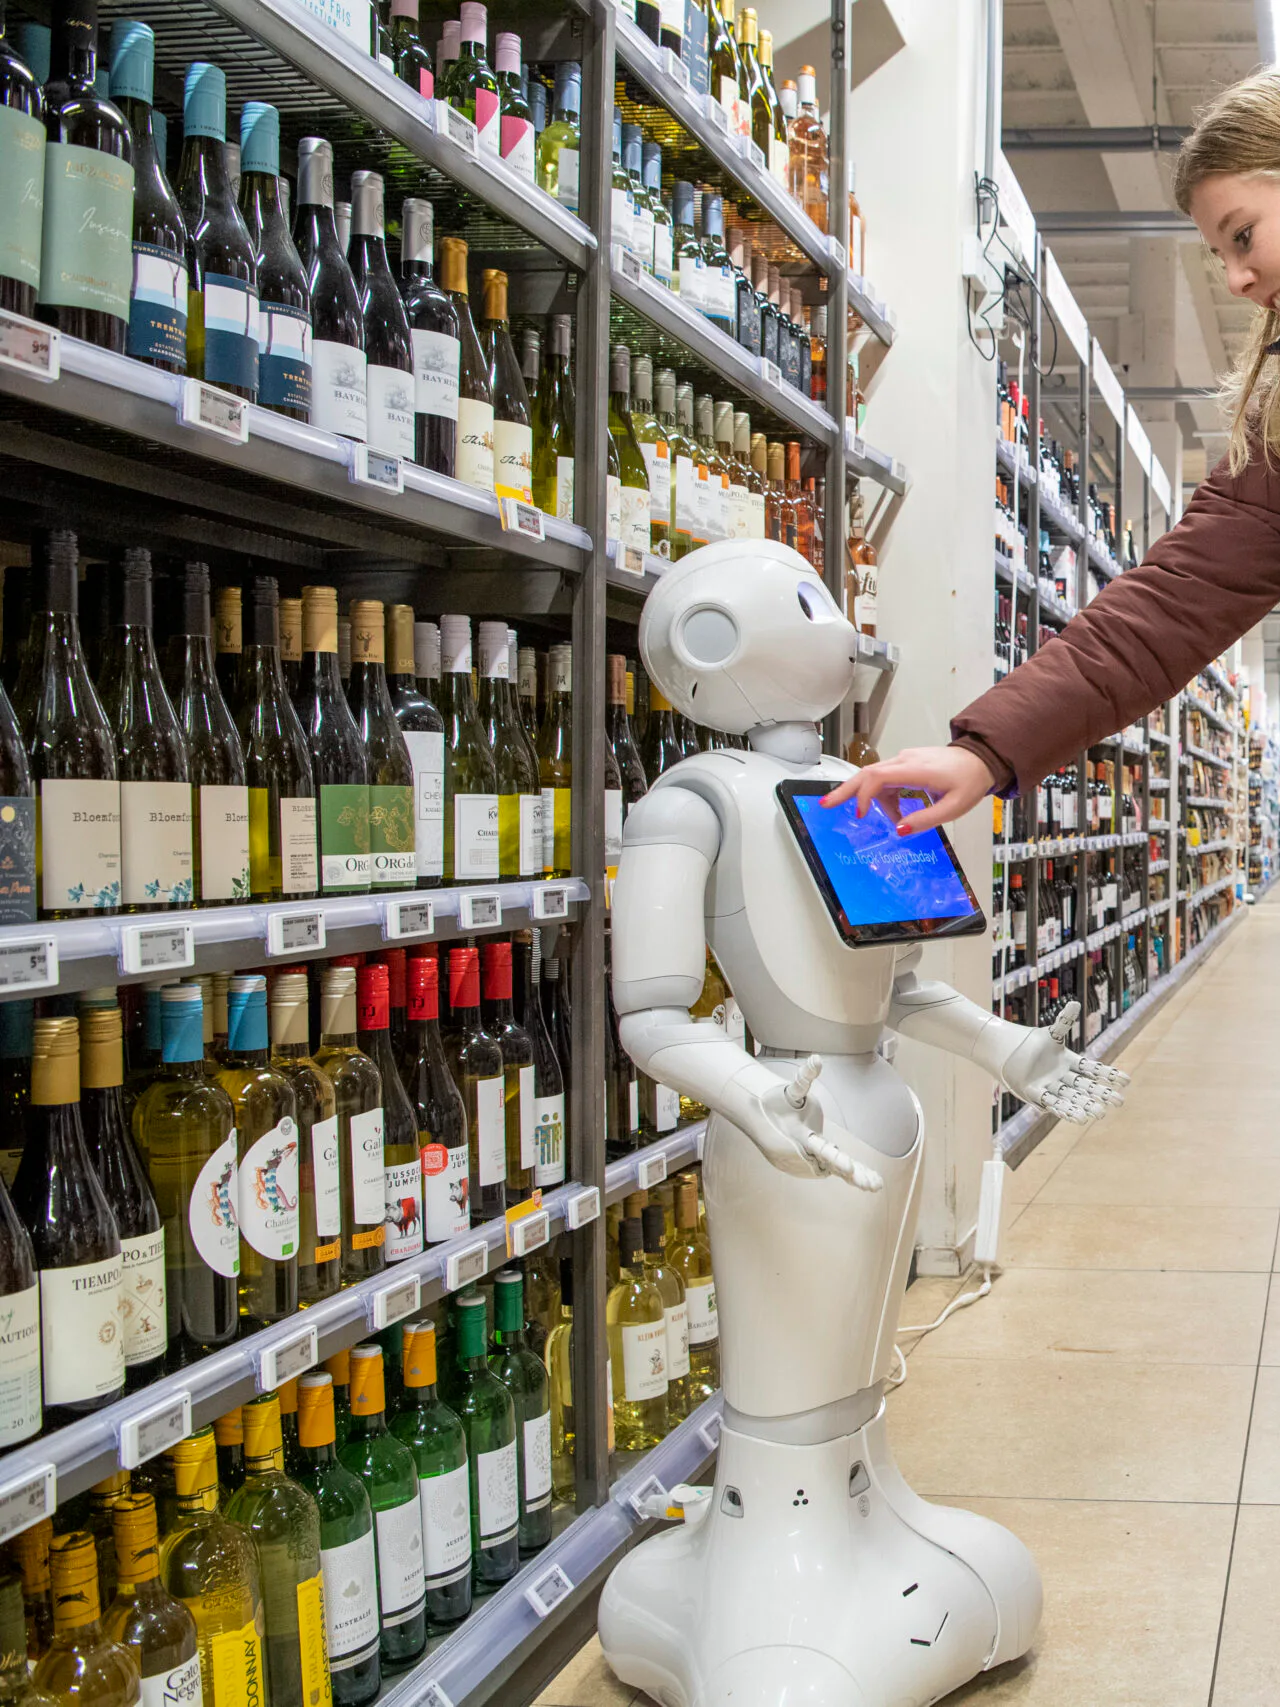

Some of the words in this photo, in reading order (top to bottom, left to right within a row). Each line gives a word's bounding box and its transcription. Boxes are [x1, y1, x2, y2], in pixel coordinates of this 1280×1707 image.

[834, 851, 857, 865] You
[879, 849, 909, 865] lovely
[167, 1664, 199, 1690] Gato
